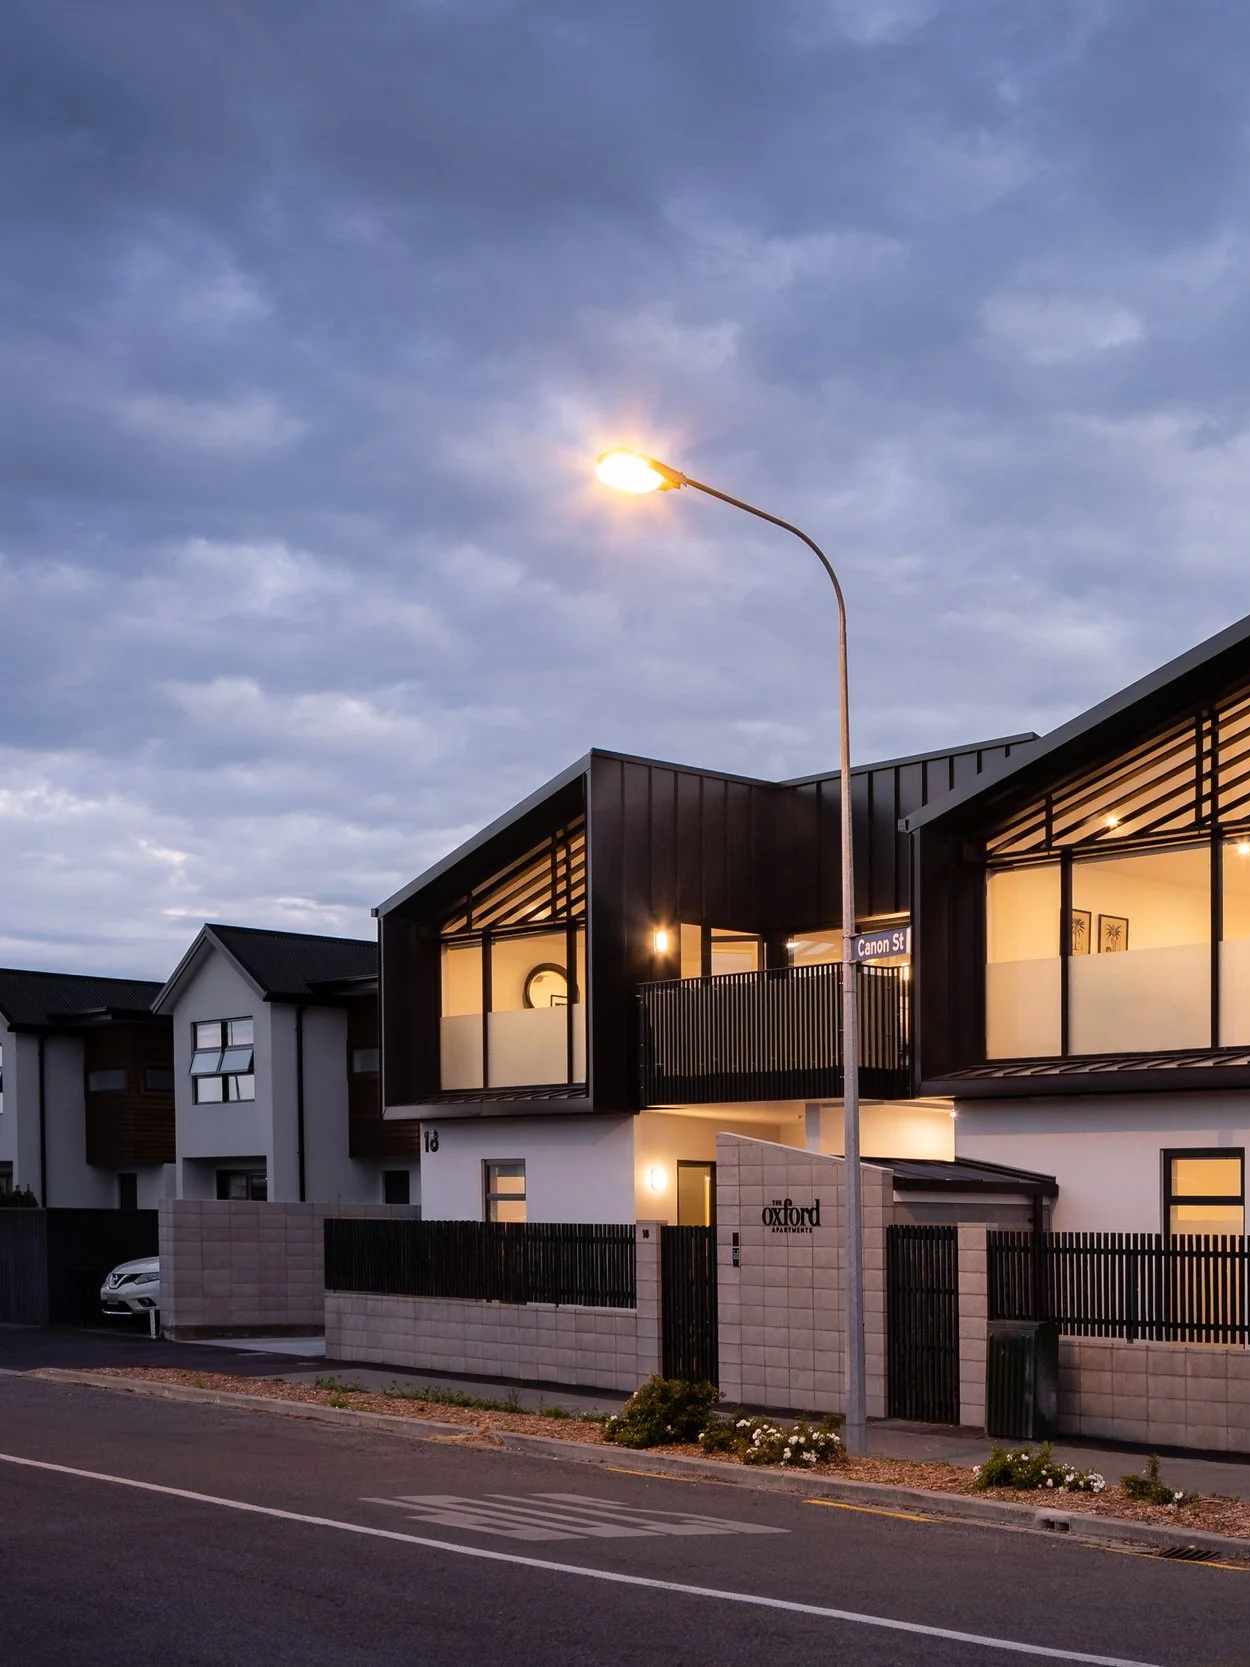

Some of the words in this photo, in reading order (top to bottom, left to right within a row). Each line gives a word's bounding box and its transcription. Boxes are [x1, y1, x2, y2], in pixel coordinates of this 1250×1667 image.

[857, 938, 890, 957] Canon
[892, 932, 905, 951] St
[424, 1130, 439, 1153] 18
[762, 1198, 821, 1227] oxford
